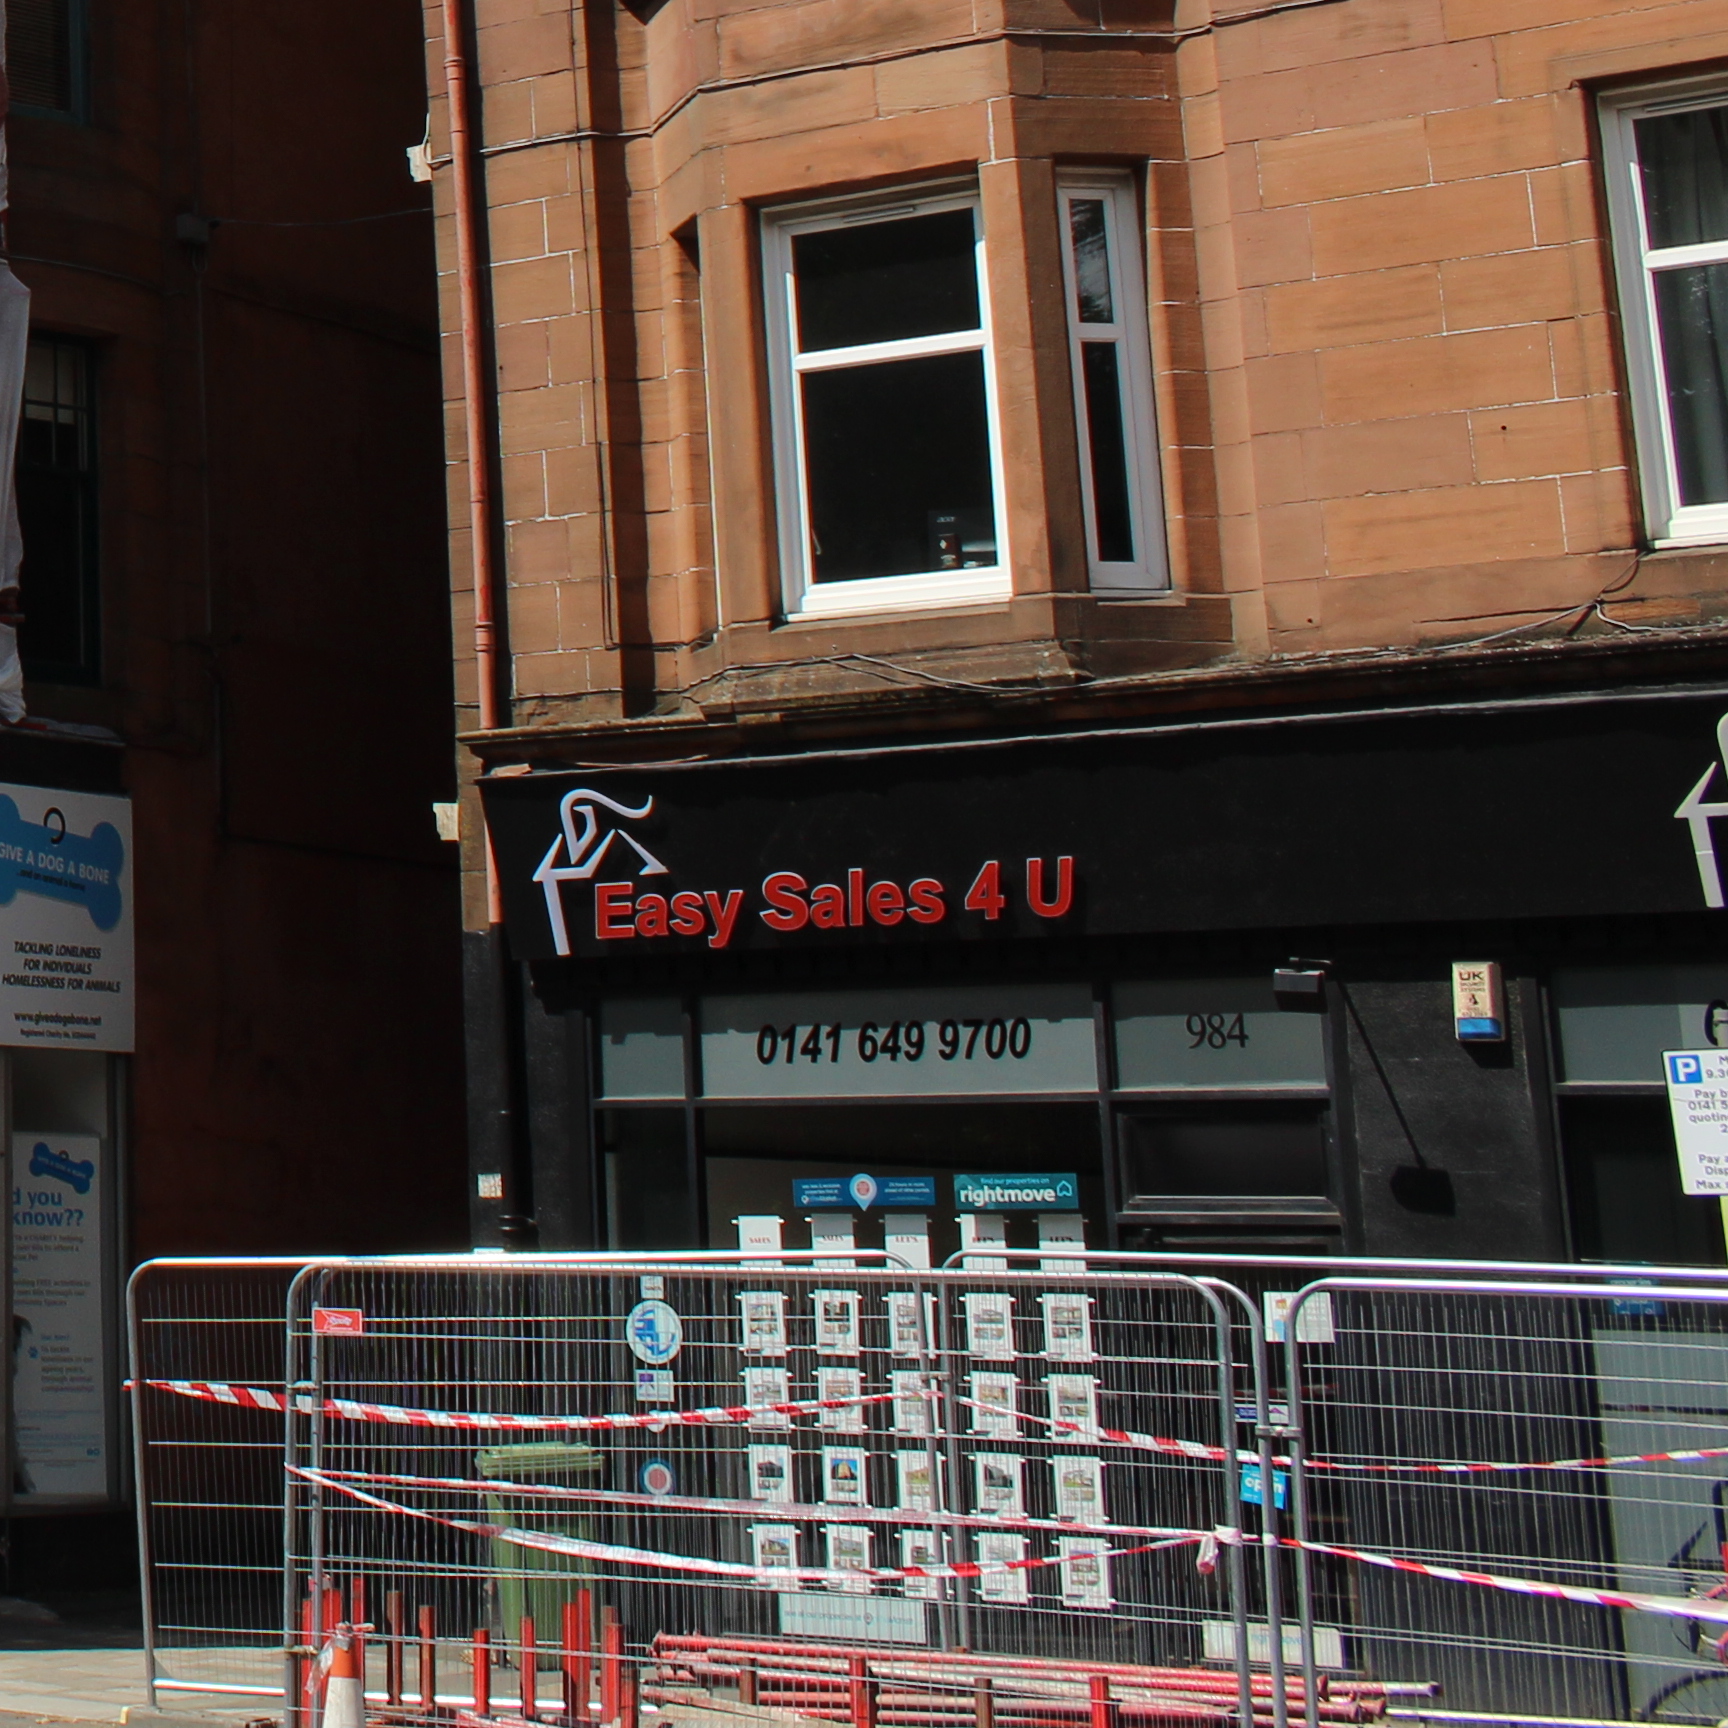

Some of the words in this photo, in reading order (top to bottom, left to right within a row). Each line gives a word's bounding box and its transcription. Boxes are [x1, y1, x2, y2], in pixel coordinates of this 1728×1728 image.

[26, 850, 35, 866] A
[38, 852, 64, 873] DOG
[68, 860, 76, 875] A
[78, 863, 110, 885] BONE
[595, 881, 744, 948] Easy
[759, 867, 945, 932] Sales
[964, 860, 1005, 920] 4
[1026, 855, 1073, 918] U
[14, 940, 54, 956] TACKLING
[55, 945, 102, 960] LONELINESS
[23, 958, 41, 971] FOR
[42, 959, 93, 976] INDIVIDUALS
[1459, 971, 1484, 981] UK
[2, 974, 65, 990] HOMELESSNESS
[67, 978, 84, 992] FOR
[85, 979, 121, 994] ANIMALS
[756, 1023, 842, 1065] 0141
[857, 1022, 925, 1063] 649
[937, 1016, 1031, 1061] 9700
[1186, 1012, 1250, 1050] 984
[1694, 1089, 1716, 1100] Pay
[1698, 1154, 1720, 1164] Pay
[1695, 1179, 1721, 1189] Max
[27, 1191, 63, 1210] you
[959, 1186, 1056, 1207] rightmove
